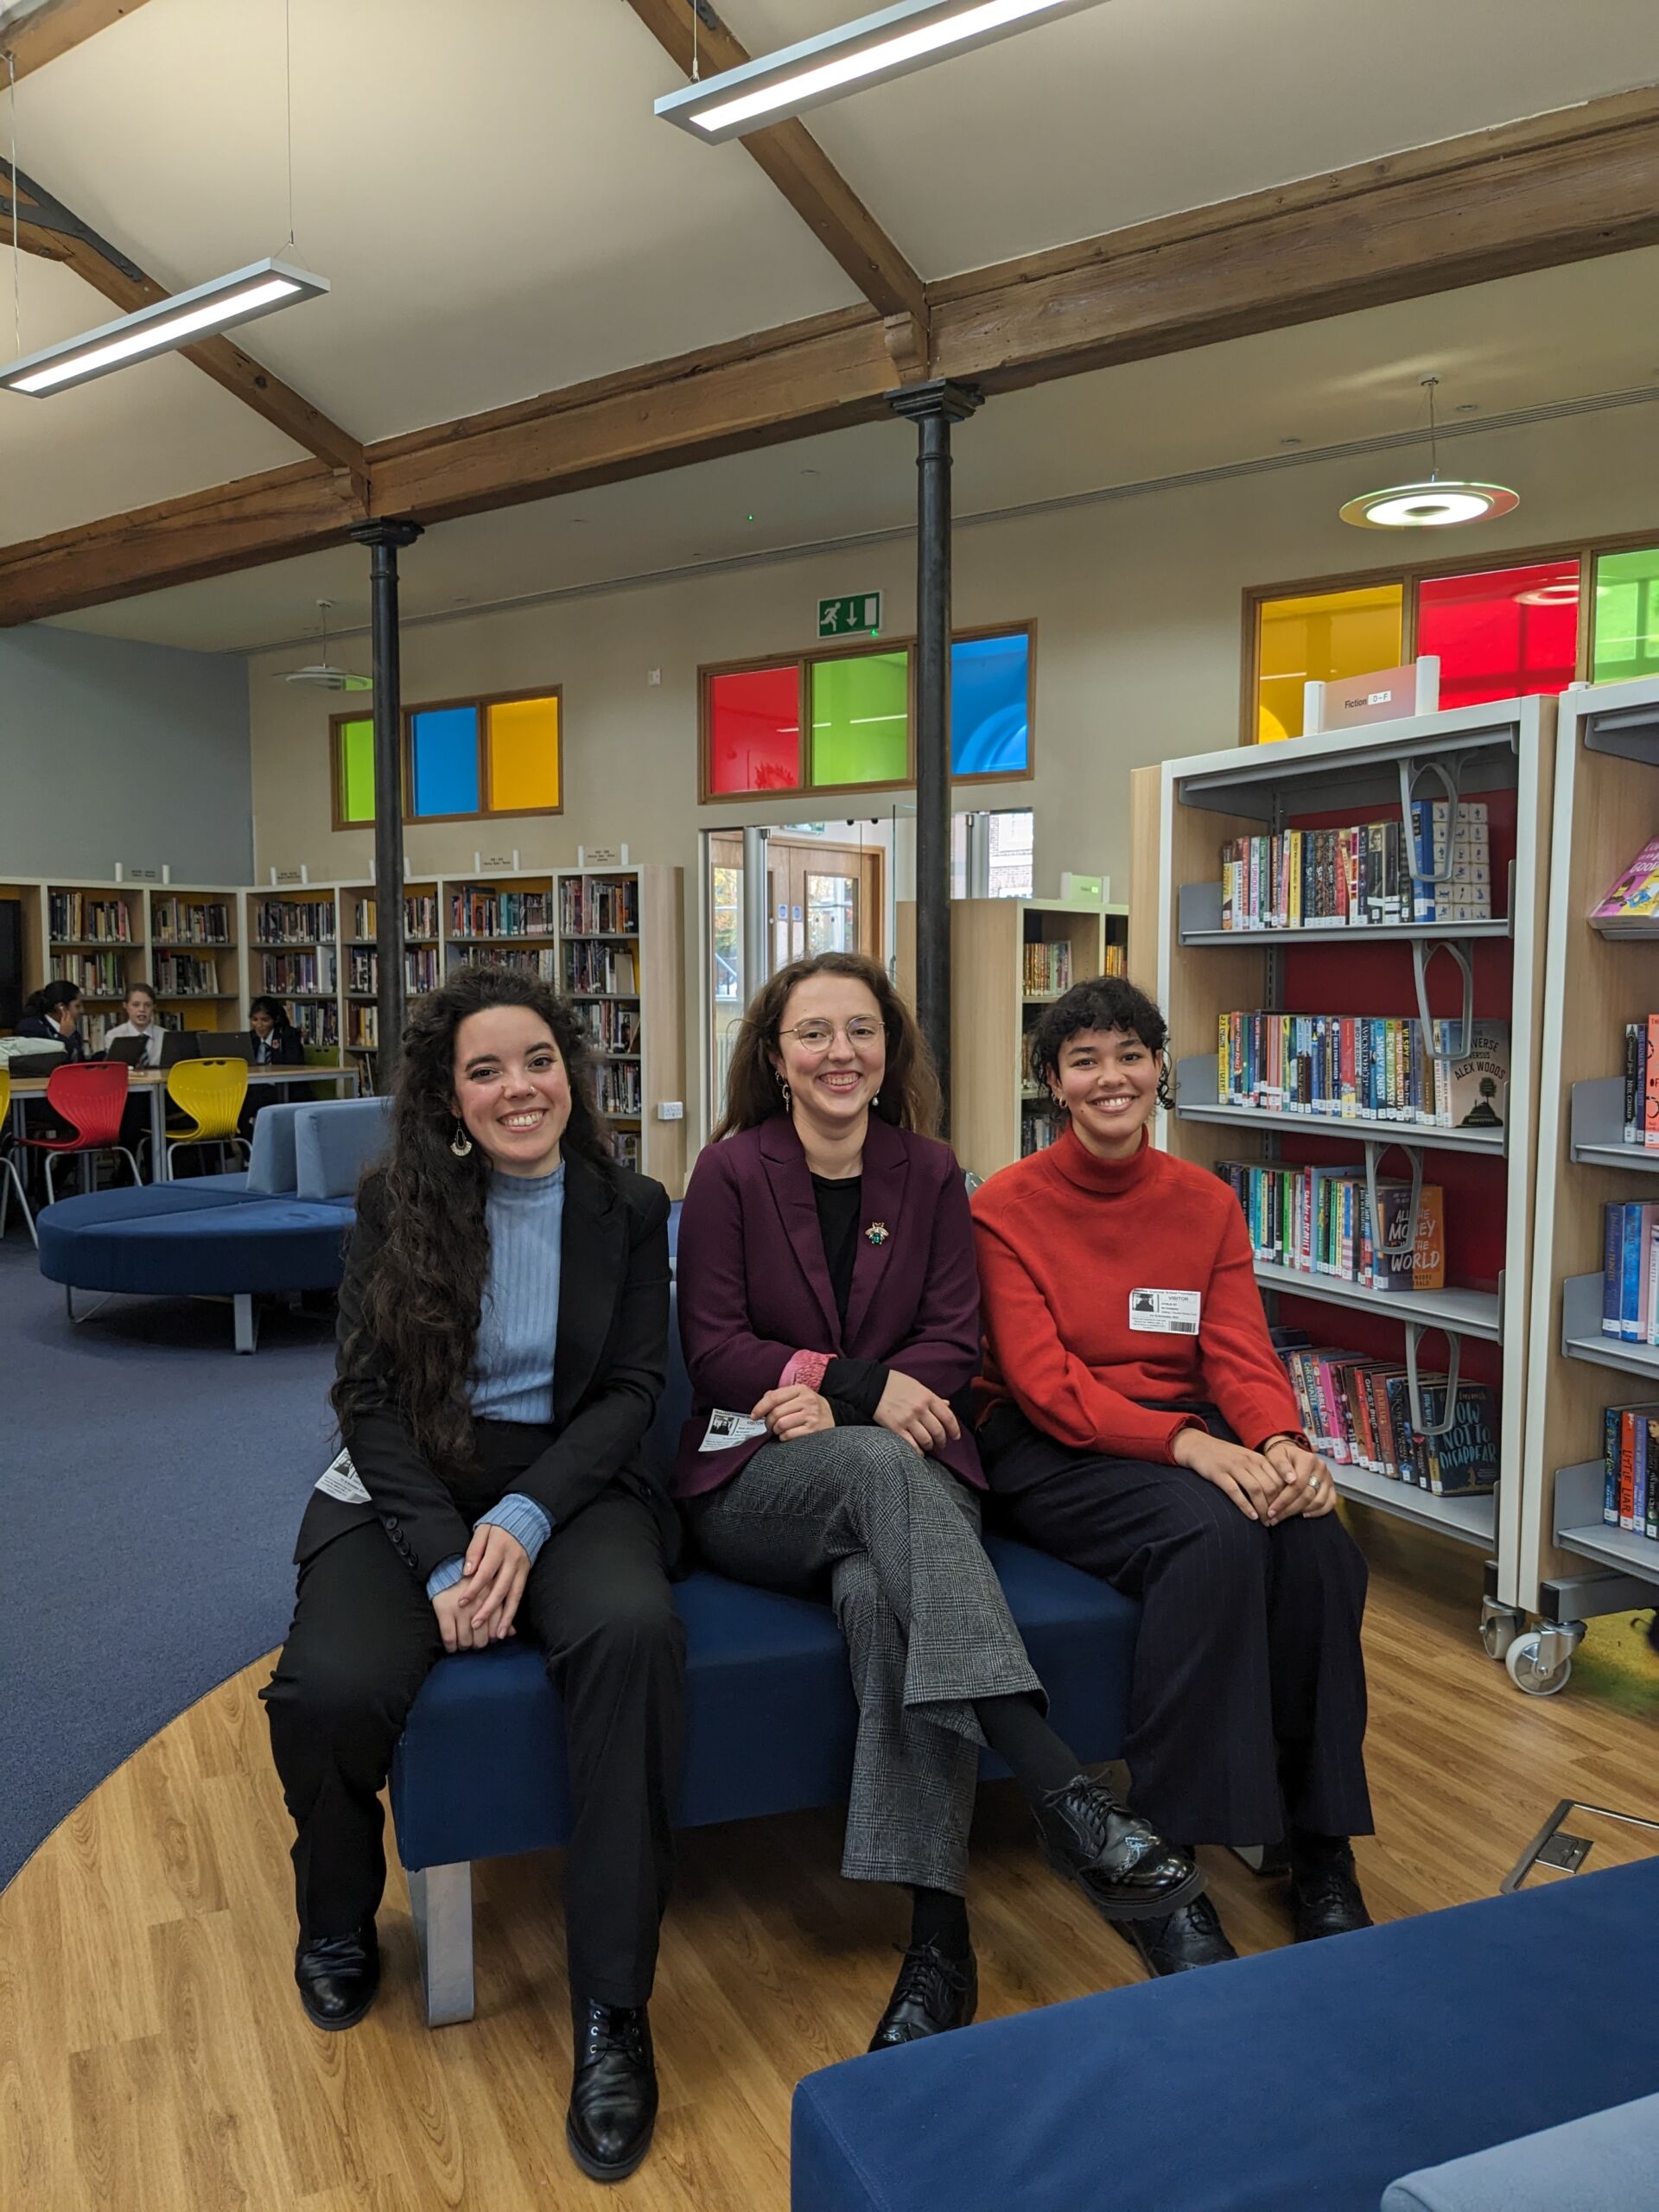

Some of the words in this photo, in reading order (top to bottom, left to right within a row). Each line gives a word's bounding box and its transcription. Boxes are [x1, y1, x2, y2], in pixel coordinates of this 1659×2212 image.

[1344, 698, 1367, 709] Fiction
[1454, 1063, 1475, 1080] ALEX
[1477, 1060, 1506, 1080] WOODS
[1376, 1074, 1385, 1100] QUEST
[1391, 1251, 1440, 1272] WORLD
[1317, 1386, 1325, 1408] BUBBLE
[1364, 1379, 1373, 1407] GHOST
[1456, 1402, 1480, 1424] OW
[1443, 1425, 1471, 1451] NOT
[1440, 1444, 1497, 1470] DISAPPEAR
[1623, 1449, 1632, 1483] LITTLE
[1622, 1487, 1633, 1513] LIAR
